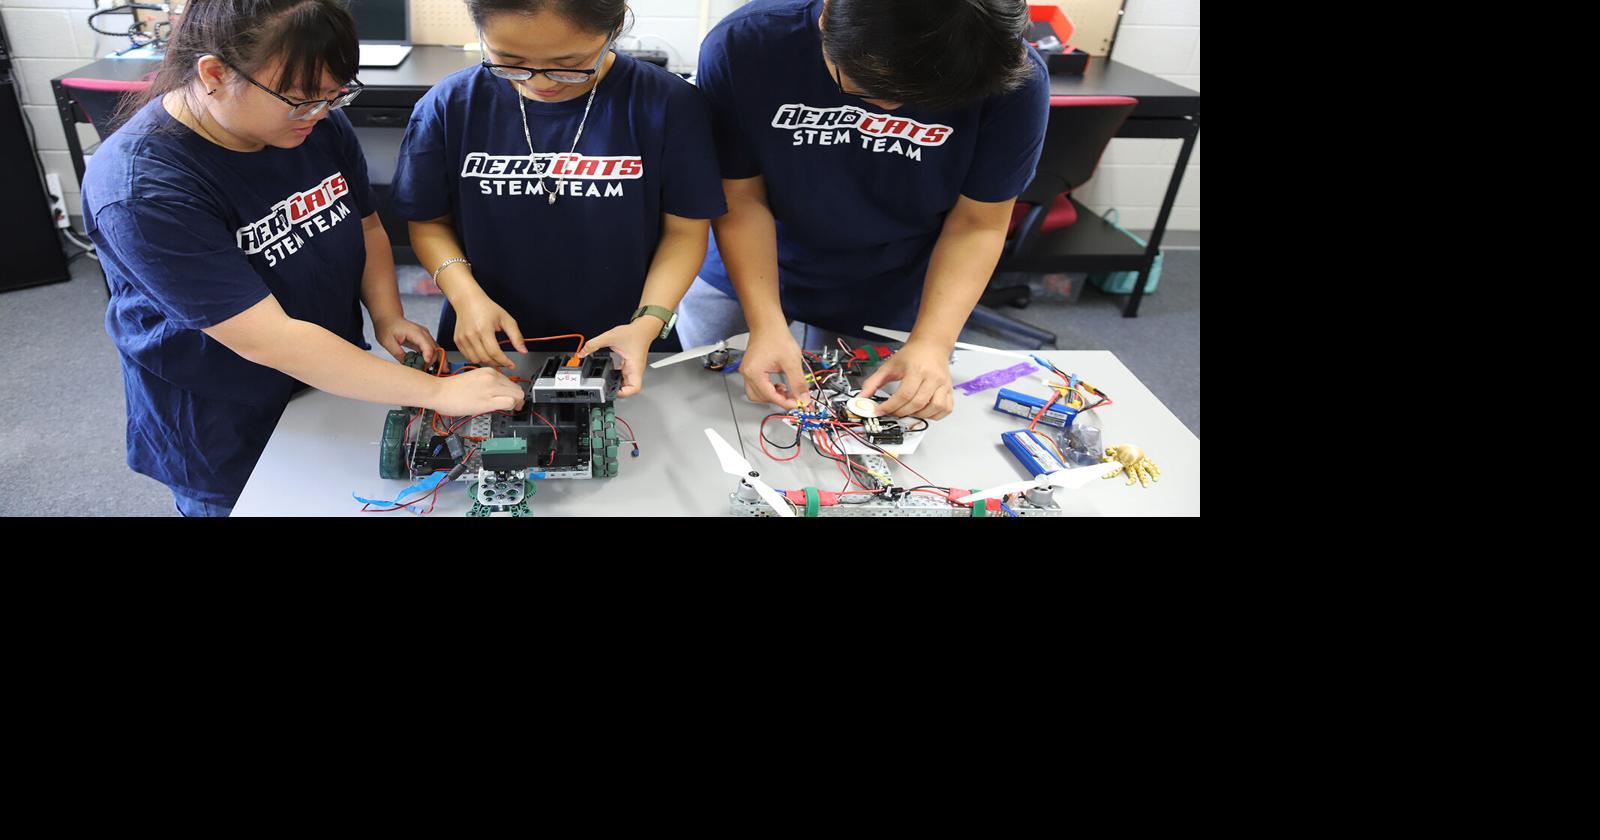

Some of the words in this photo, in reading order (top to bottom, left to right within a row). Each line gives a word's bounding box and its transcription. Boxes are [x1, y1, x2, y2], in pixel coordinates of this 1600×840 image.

[793, 129, 851, 146] STEM
[860, 135, 922, 162] TEAM
[479, 180, 544, 196] STEM
[555, 181, 624, 197] TEAM
[300, 201, 351, 238] TEAM
